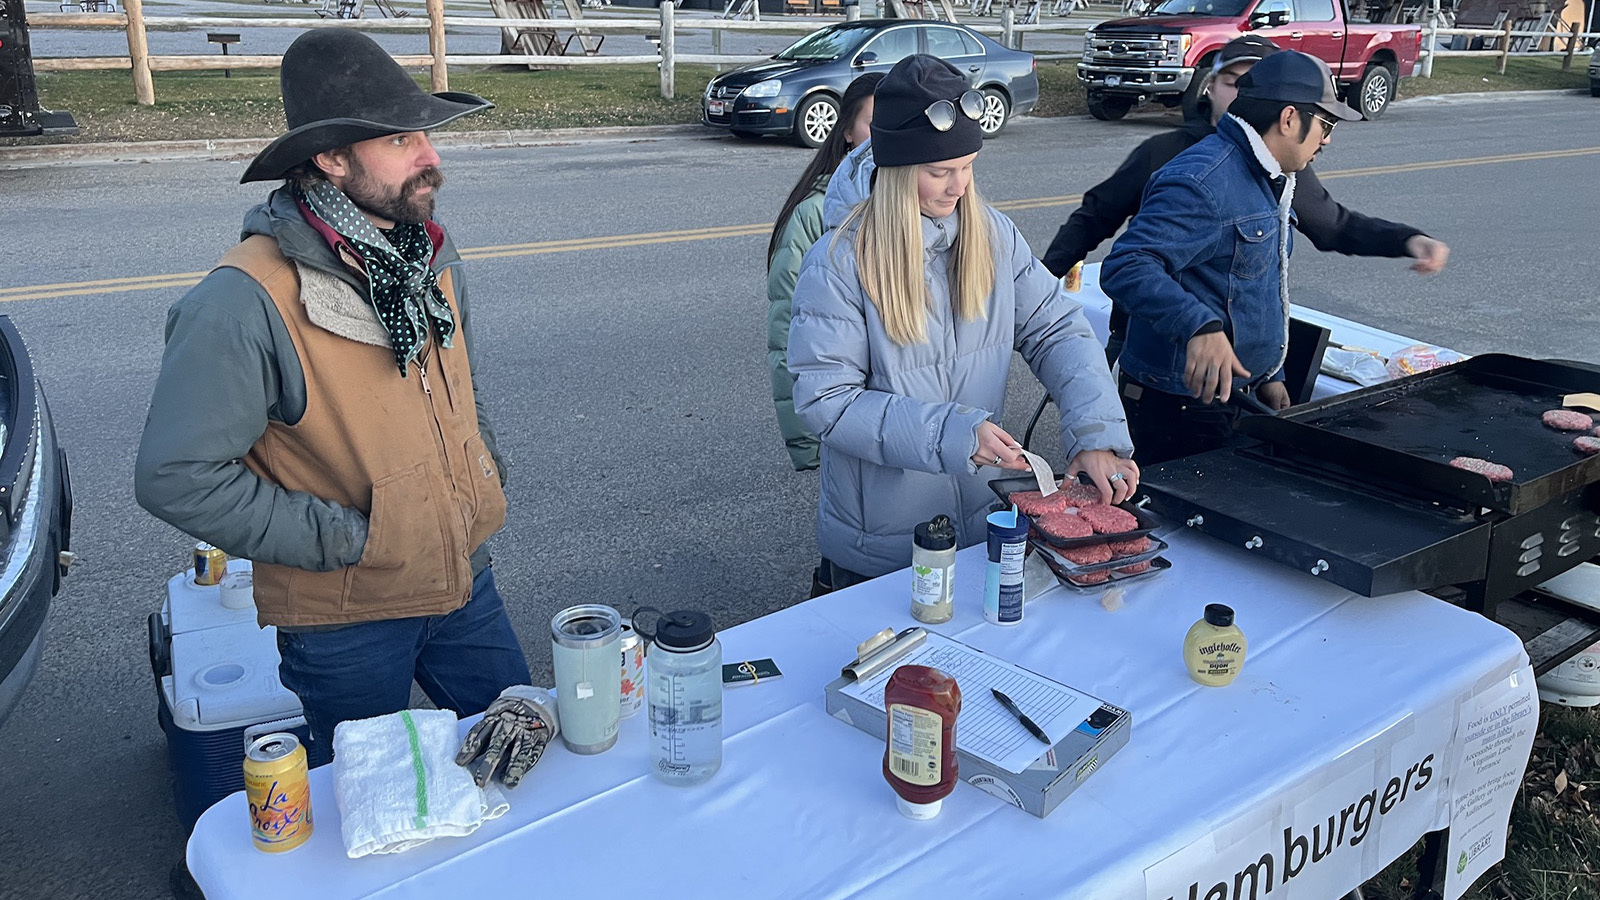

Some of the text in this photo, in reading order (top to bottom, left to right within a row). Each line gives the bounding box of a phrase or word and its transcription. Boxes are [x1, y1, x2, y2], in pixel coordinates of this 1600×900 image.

[1467, 715, 1484, 731] Food
[1489, 705, 1508, 720] ONLY
[260, 780, 288, 812] La
[1469, 835, 1492, 860] LIBRARY
